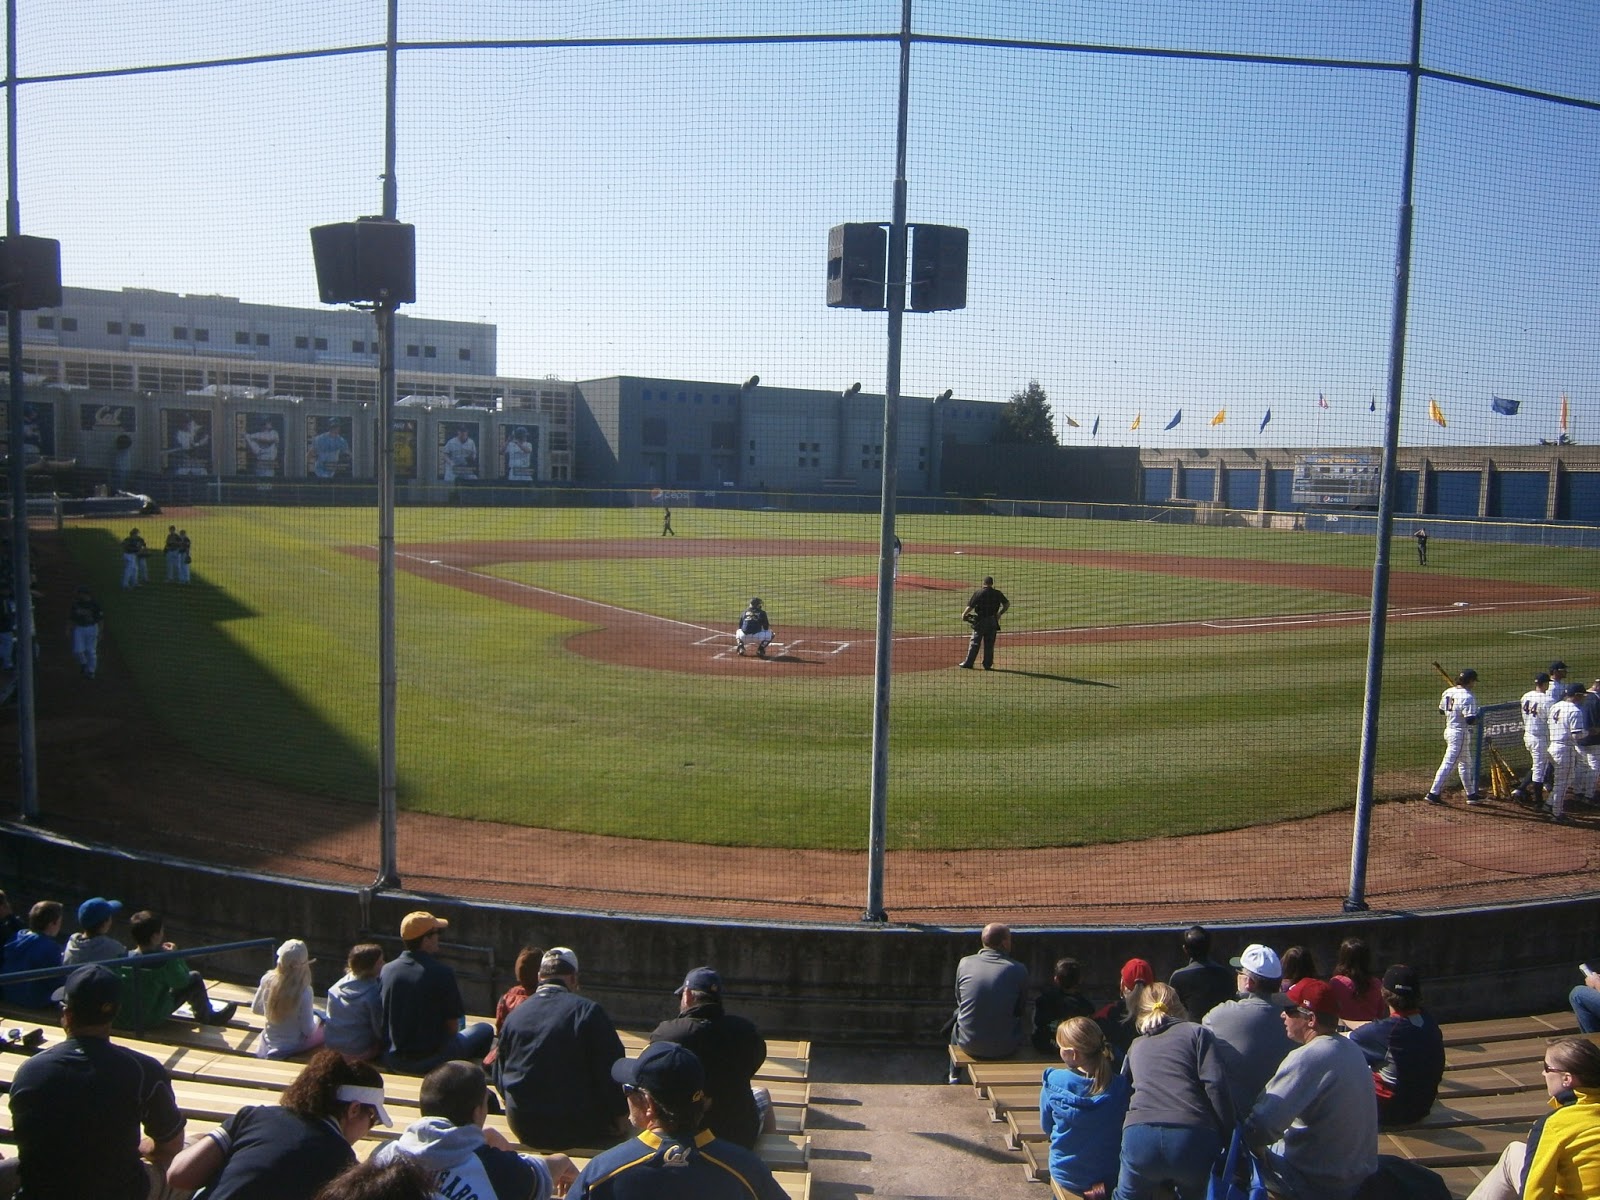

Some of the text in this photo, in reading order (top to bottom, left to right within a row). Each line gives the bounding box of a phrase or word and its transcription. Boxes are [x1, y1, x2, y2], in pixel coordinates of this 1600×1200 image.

[95, 405, 122, 426] Cal
[664, 492, 689, 500] pepsi
[1523, 700, 1538, 717] 44
[1553, 709, 1561, 724] 4
[662, 1145, 691, 1167] Cal
